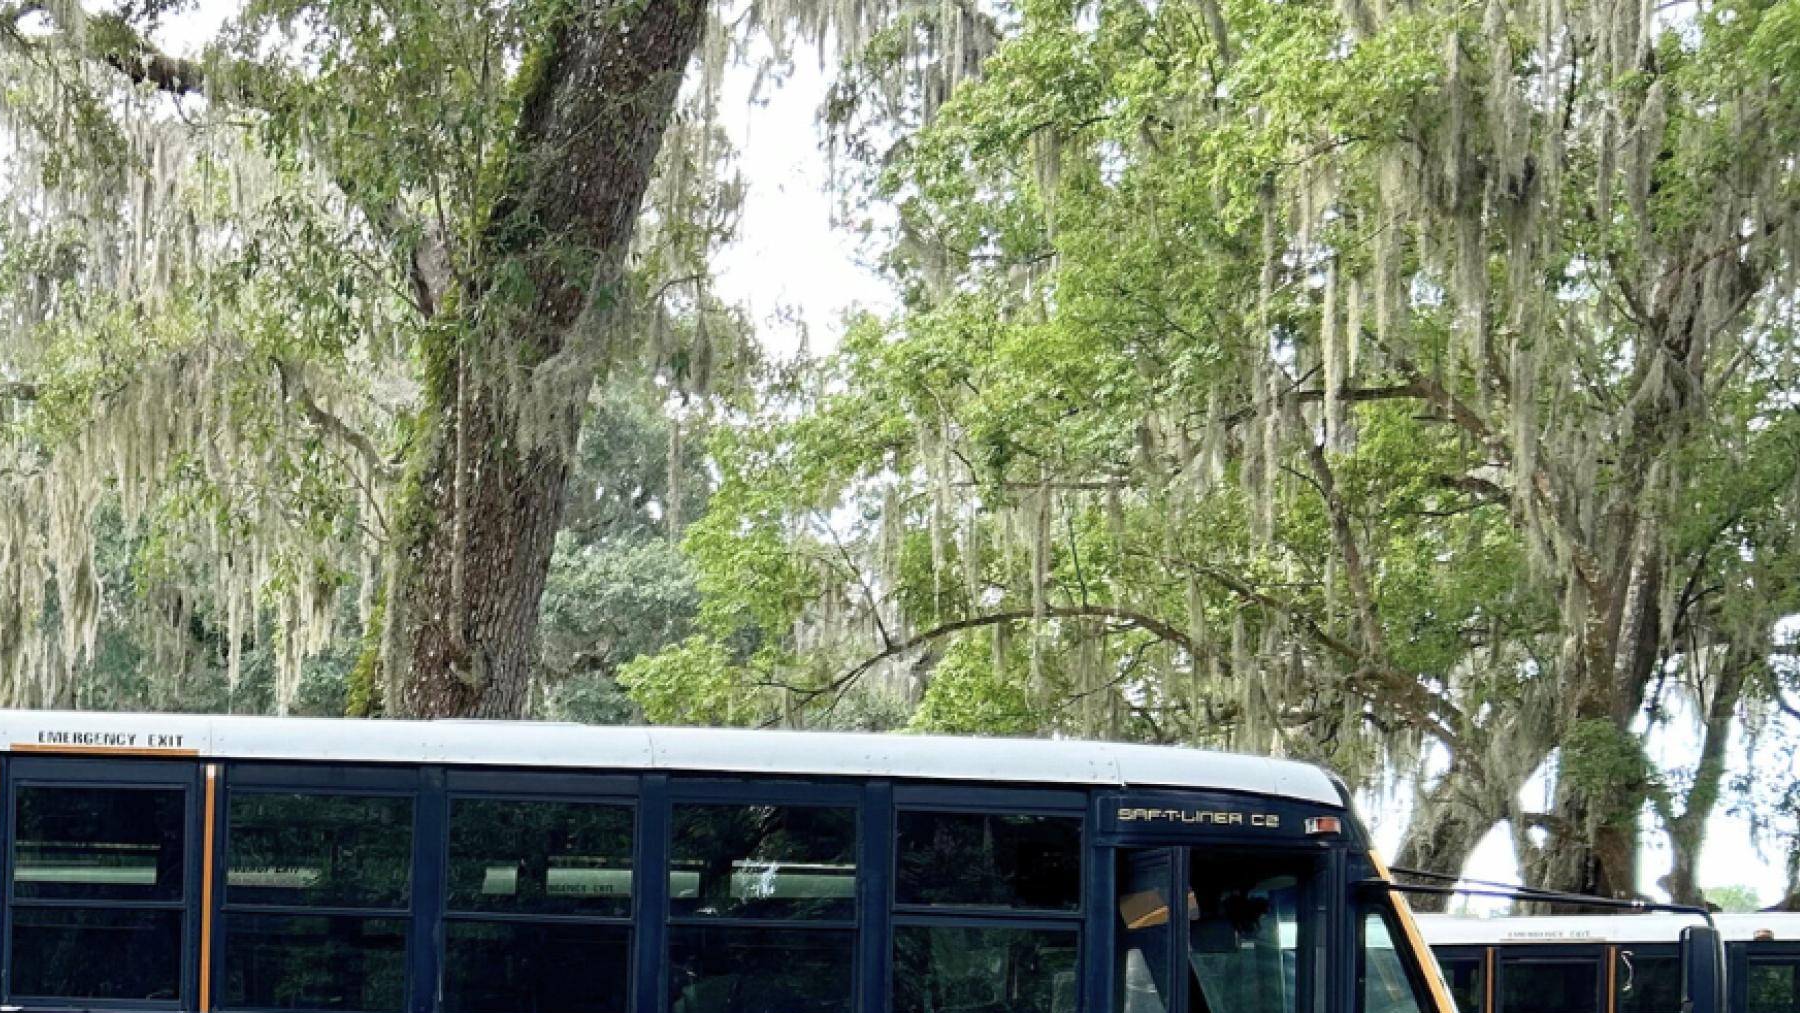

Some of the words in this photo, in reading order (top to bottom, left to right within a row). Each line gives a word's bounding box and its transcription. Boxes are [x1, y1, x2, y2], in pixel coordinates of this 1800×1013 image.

[38, 730, 136, 746] EMERGENCY
[147, 734, 183, 747] EXIT
[1251, 814, 1280, 828] C2
